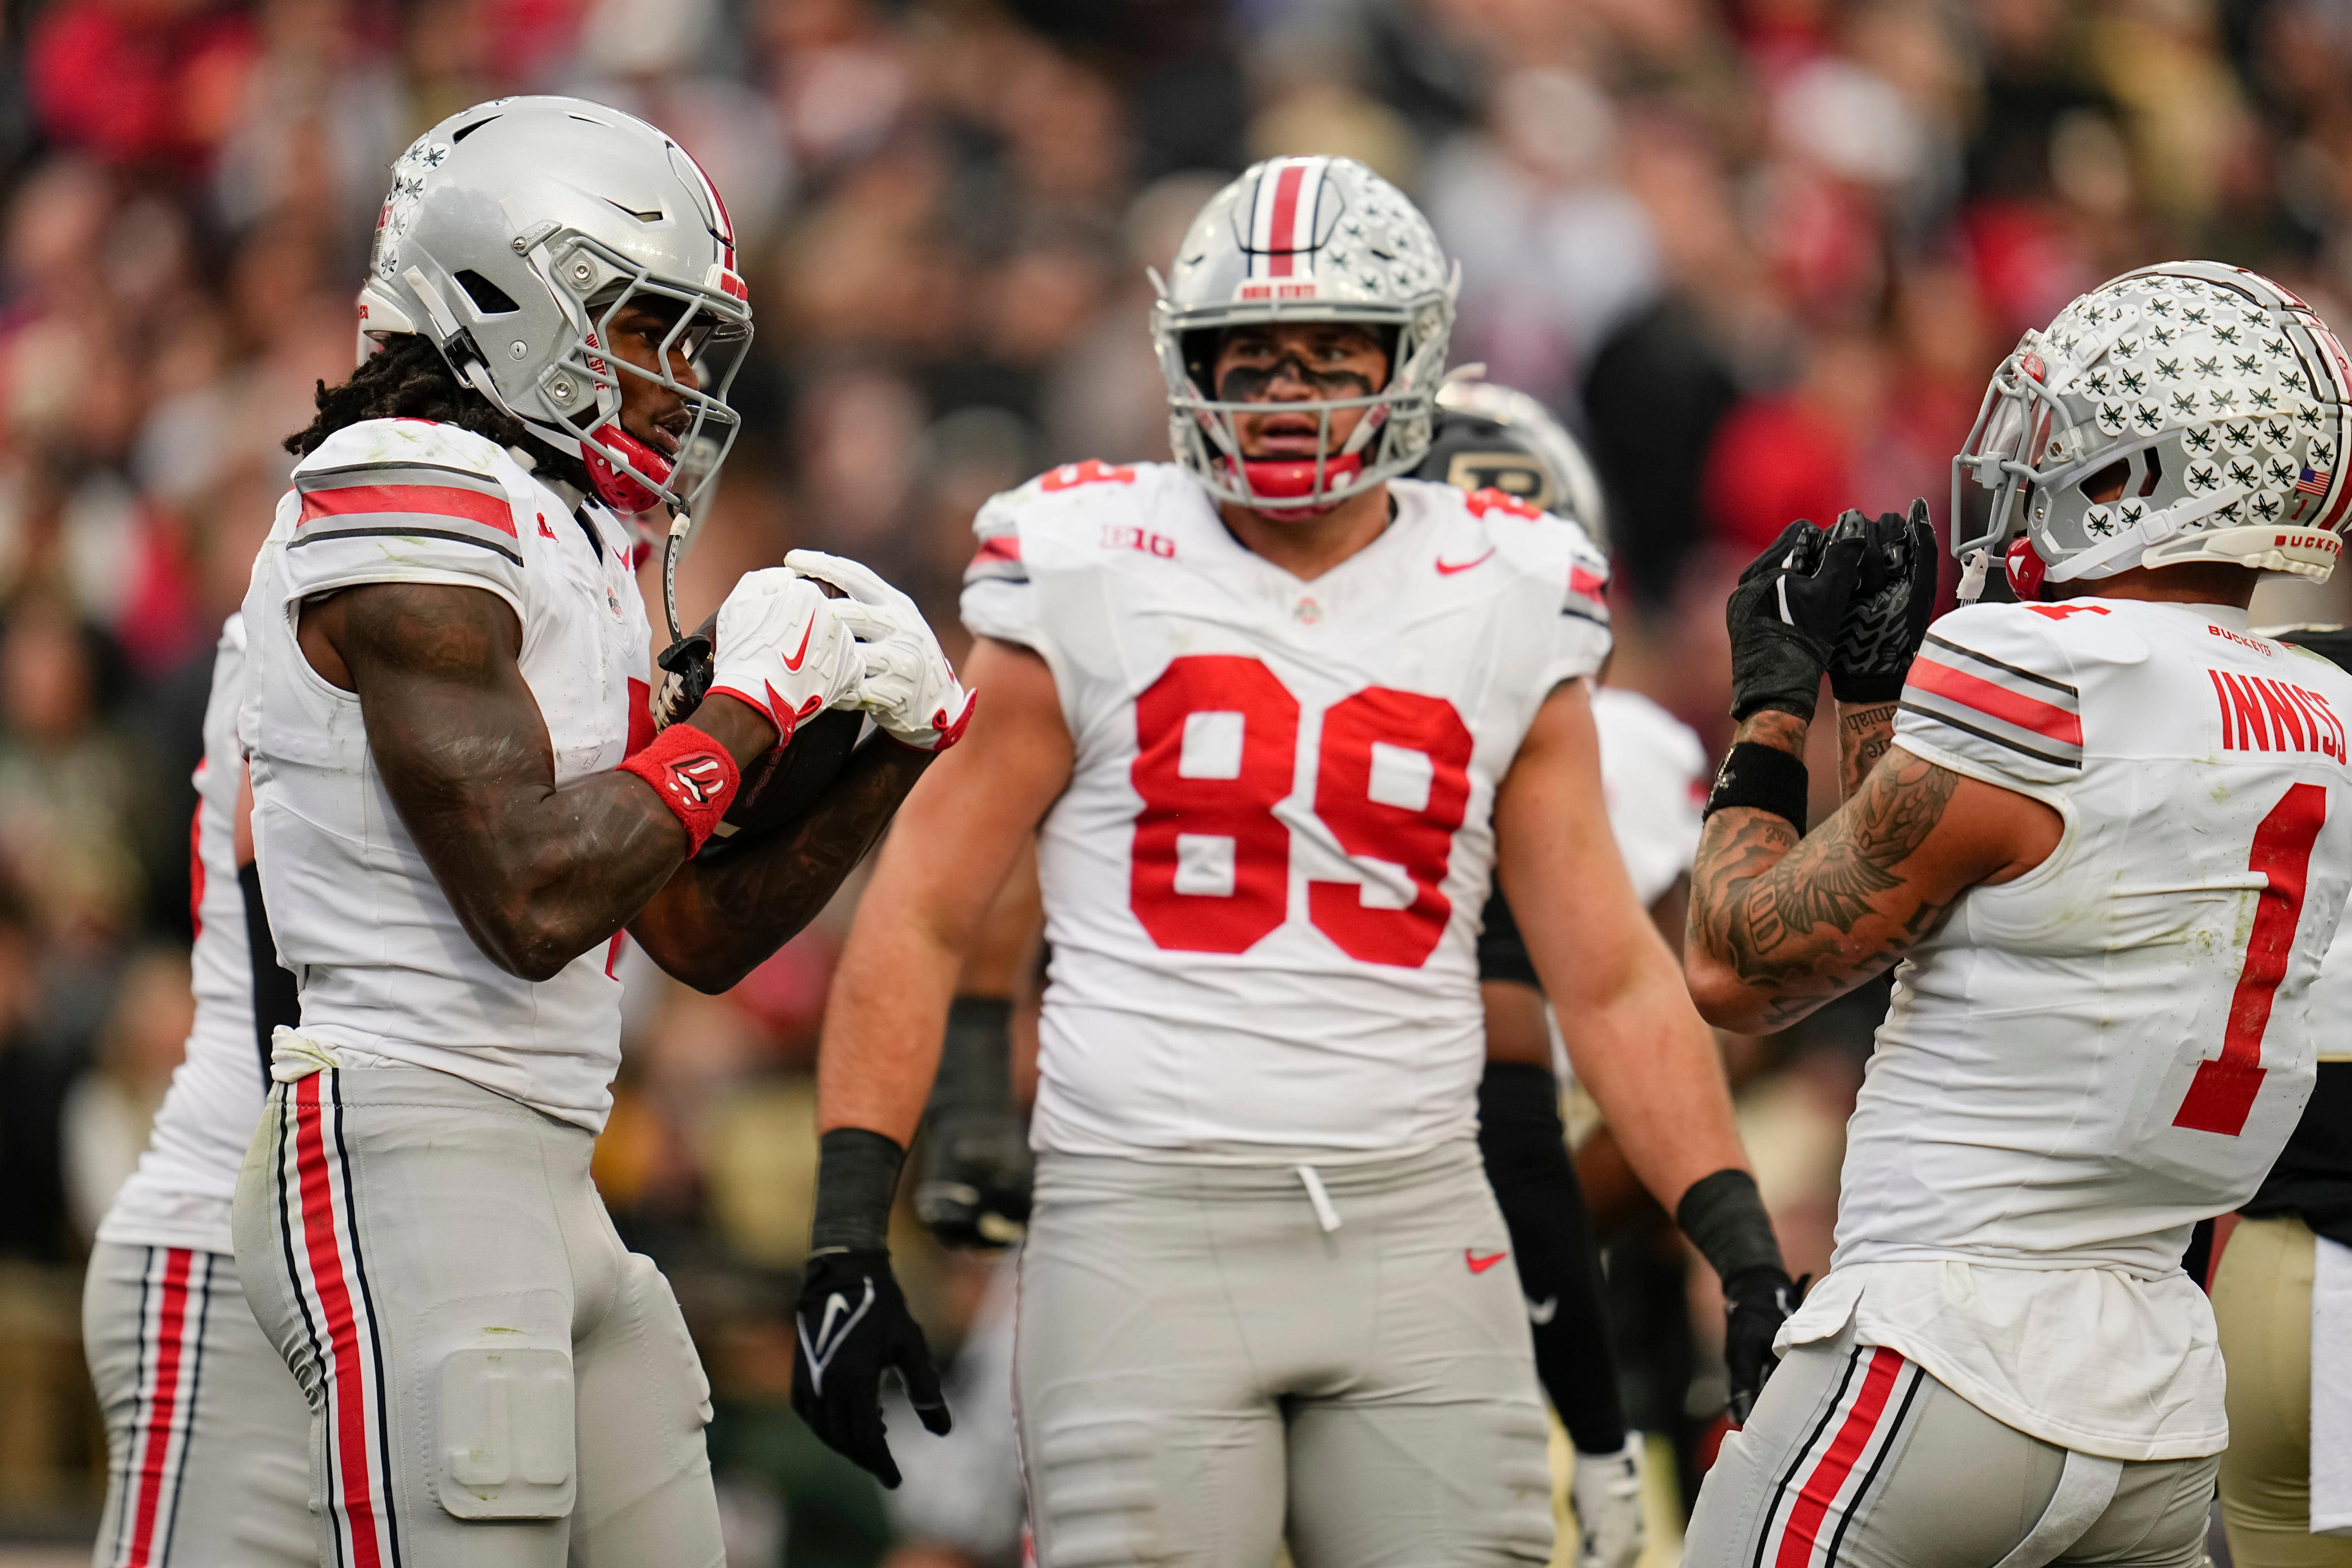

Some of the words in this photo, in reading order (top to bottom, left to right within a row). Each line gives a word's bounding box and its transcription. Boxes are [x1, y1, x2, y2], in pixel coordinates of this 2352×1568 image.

[585, 333, 599, 358] OH
[589, 359, 610, 391] STE
[2208, 669, 2346, 766] INNISS
[1130, 654, 1474, 969] 89
[2172, 782, 2326, 1137] 1
